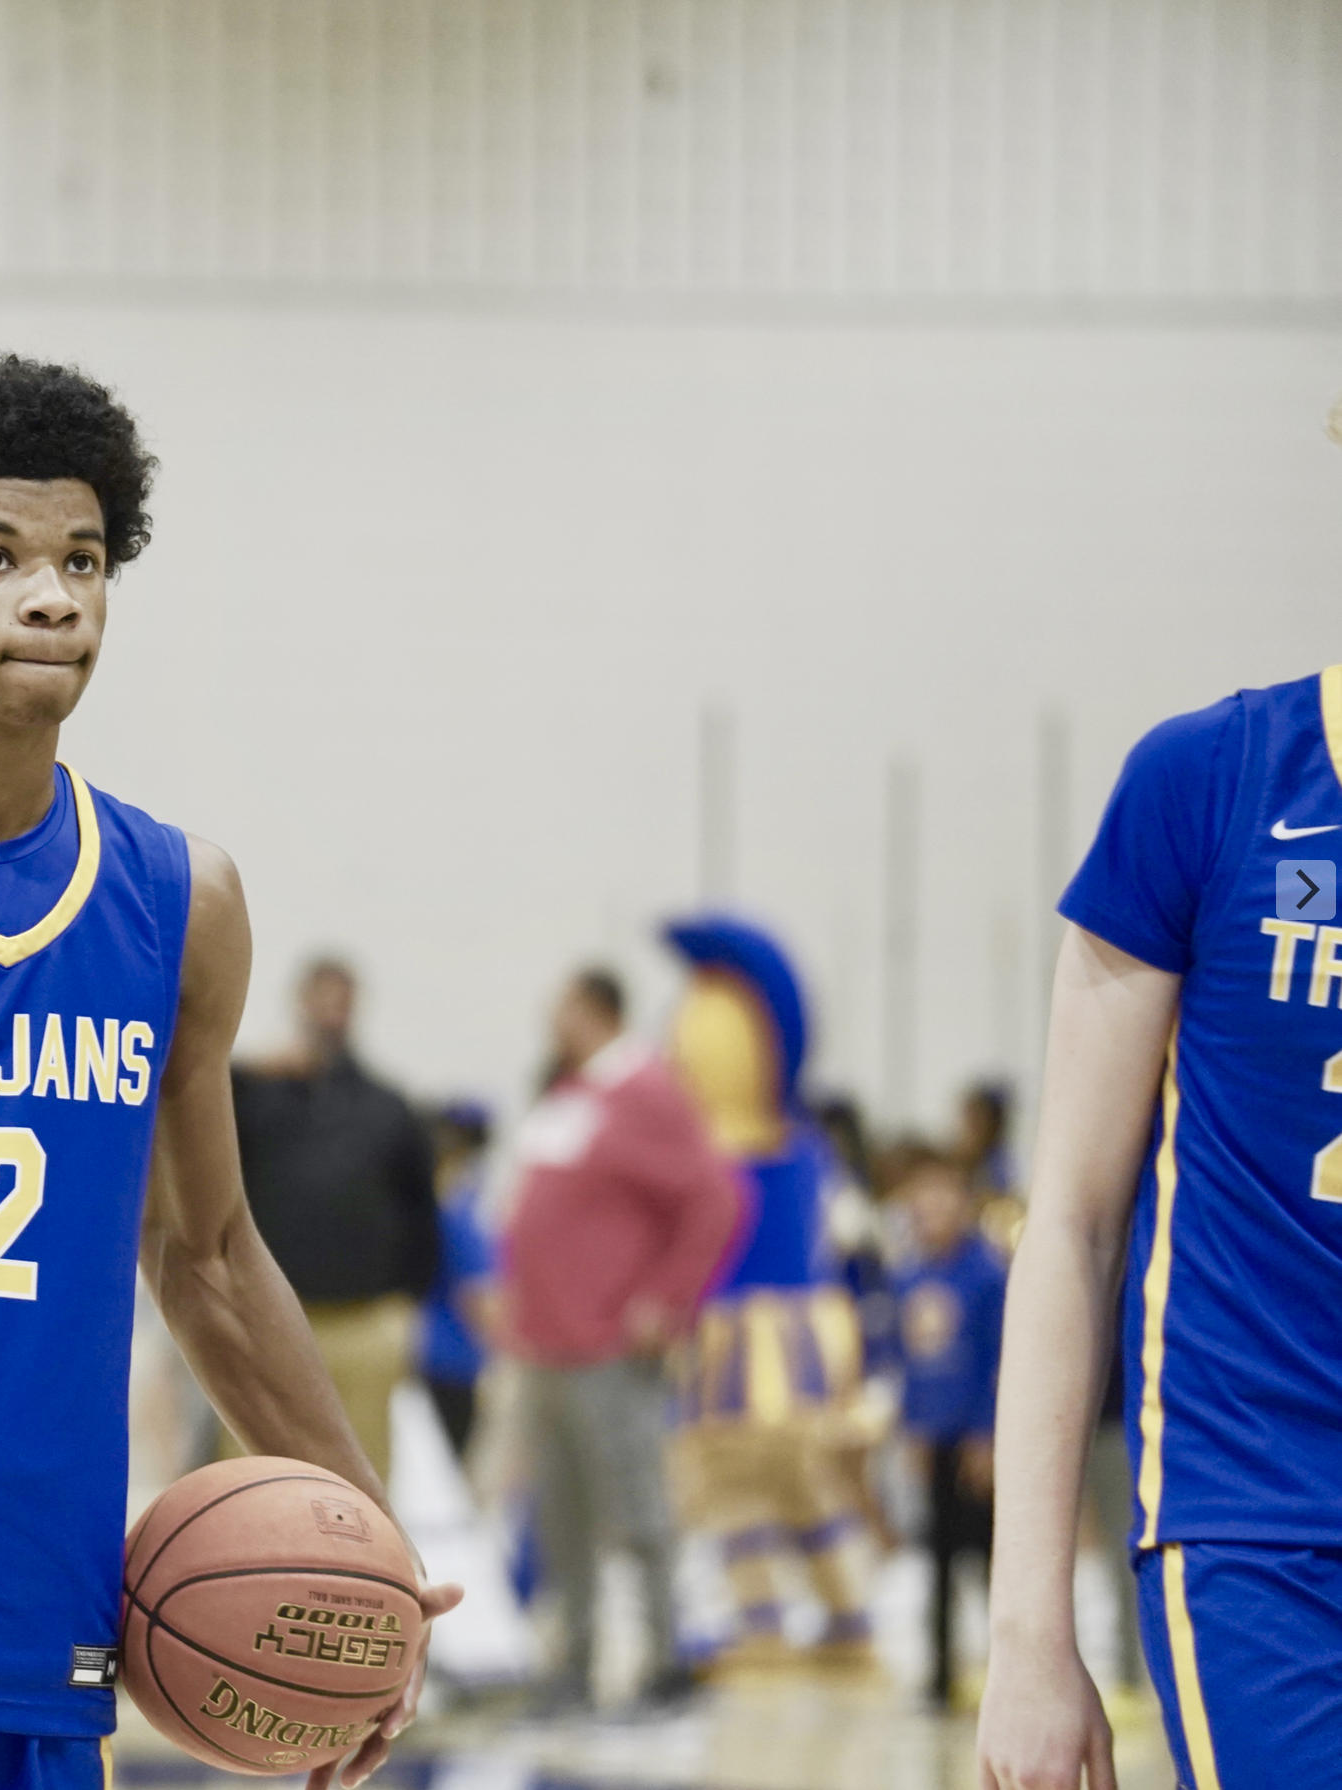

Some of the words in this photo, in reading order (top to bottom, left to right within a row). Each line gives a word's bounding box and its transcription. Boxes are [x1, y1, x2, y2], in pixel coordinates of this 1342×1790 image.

[308, 1590, 328, 1603] BALL
[330, 1593, 353, 1606] GAME
[276, 1602, 376, 1631] 1000
[253, 1622, 406, 1669] LEGACY
[199, 1677, 371, 1749] PALDING
